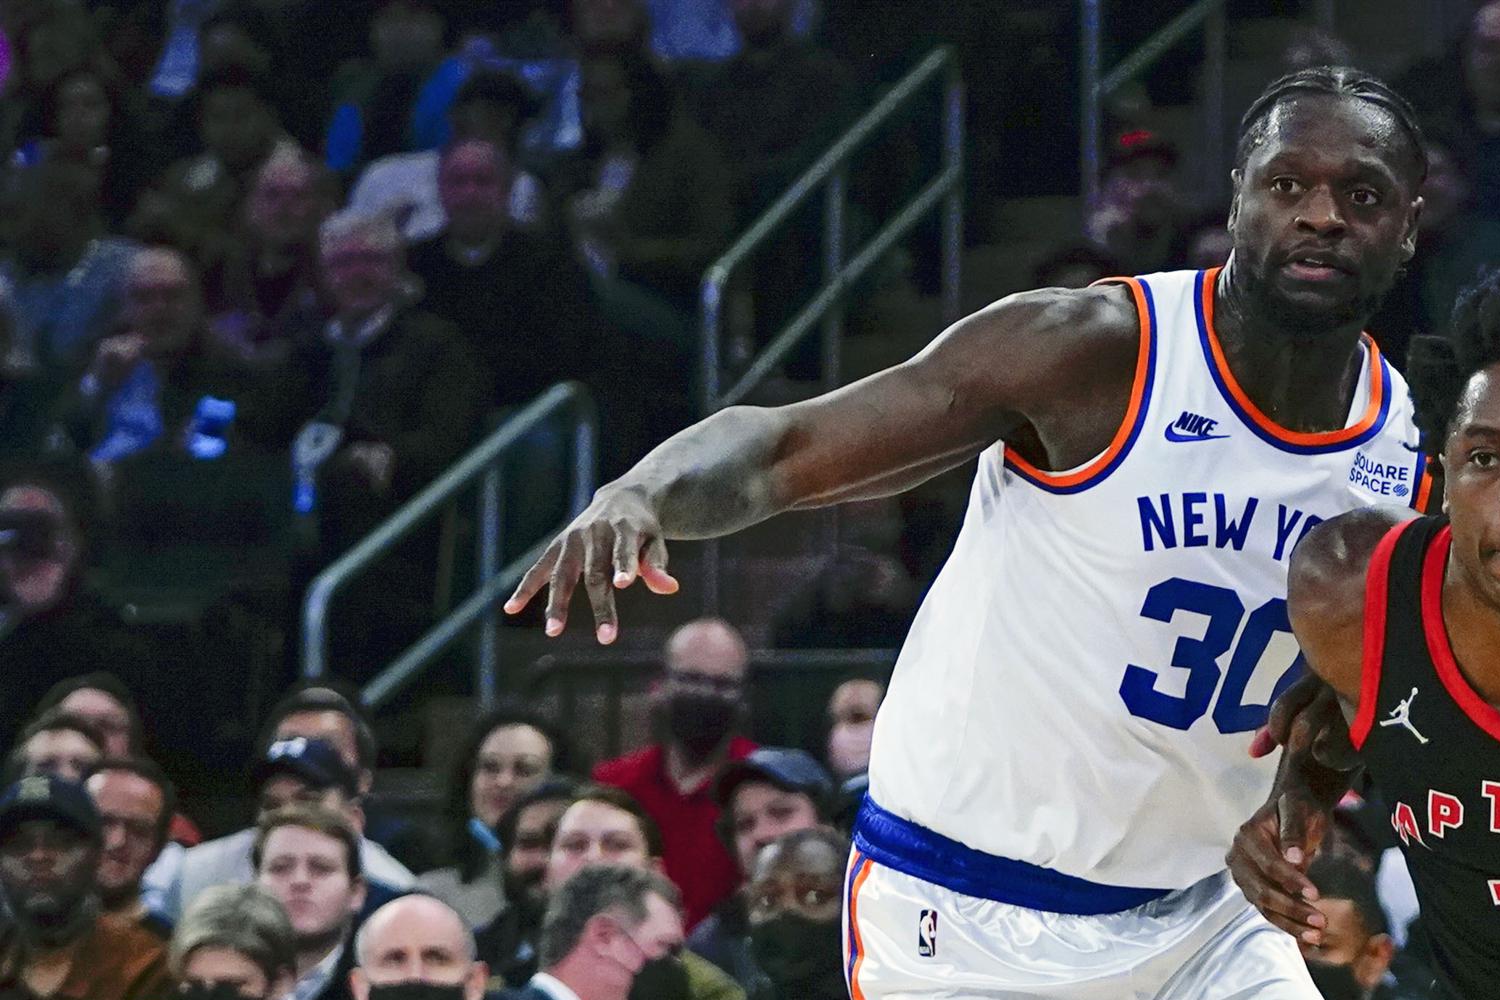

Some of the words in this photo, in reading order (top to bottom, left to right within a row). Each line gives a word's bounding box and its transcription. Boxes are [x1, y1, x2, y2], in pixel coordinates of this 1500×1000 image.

[1174, 410, 1219, 437] NIKE
[1349, 467, 1391, 495] SPACE
[1353, 451, 1409, 481] SQUARE
[1137, 492, 1259, 551] NEW
[1119, 576, 1304, 734] 30
